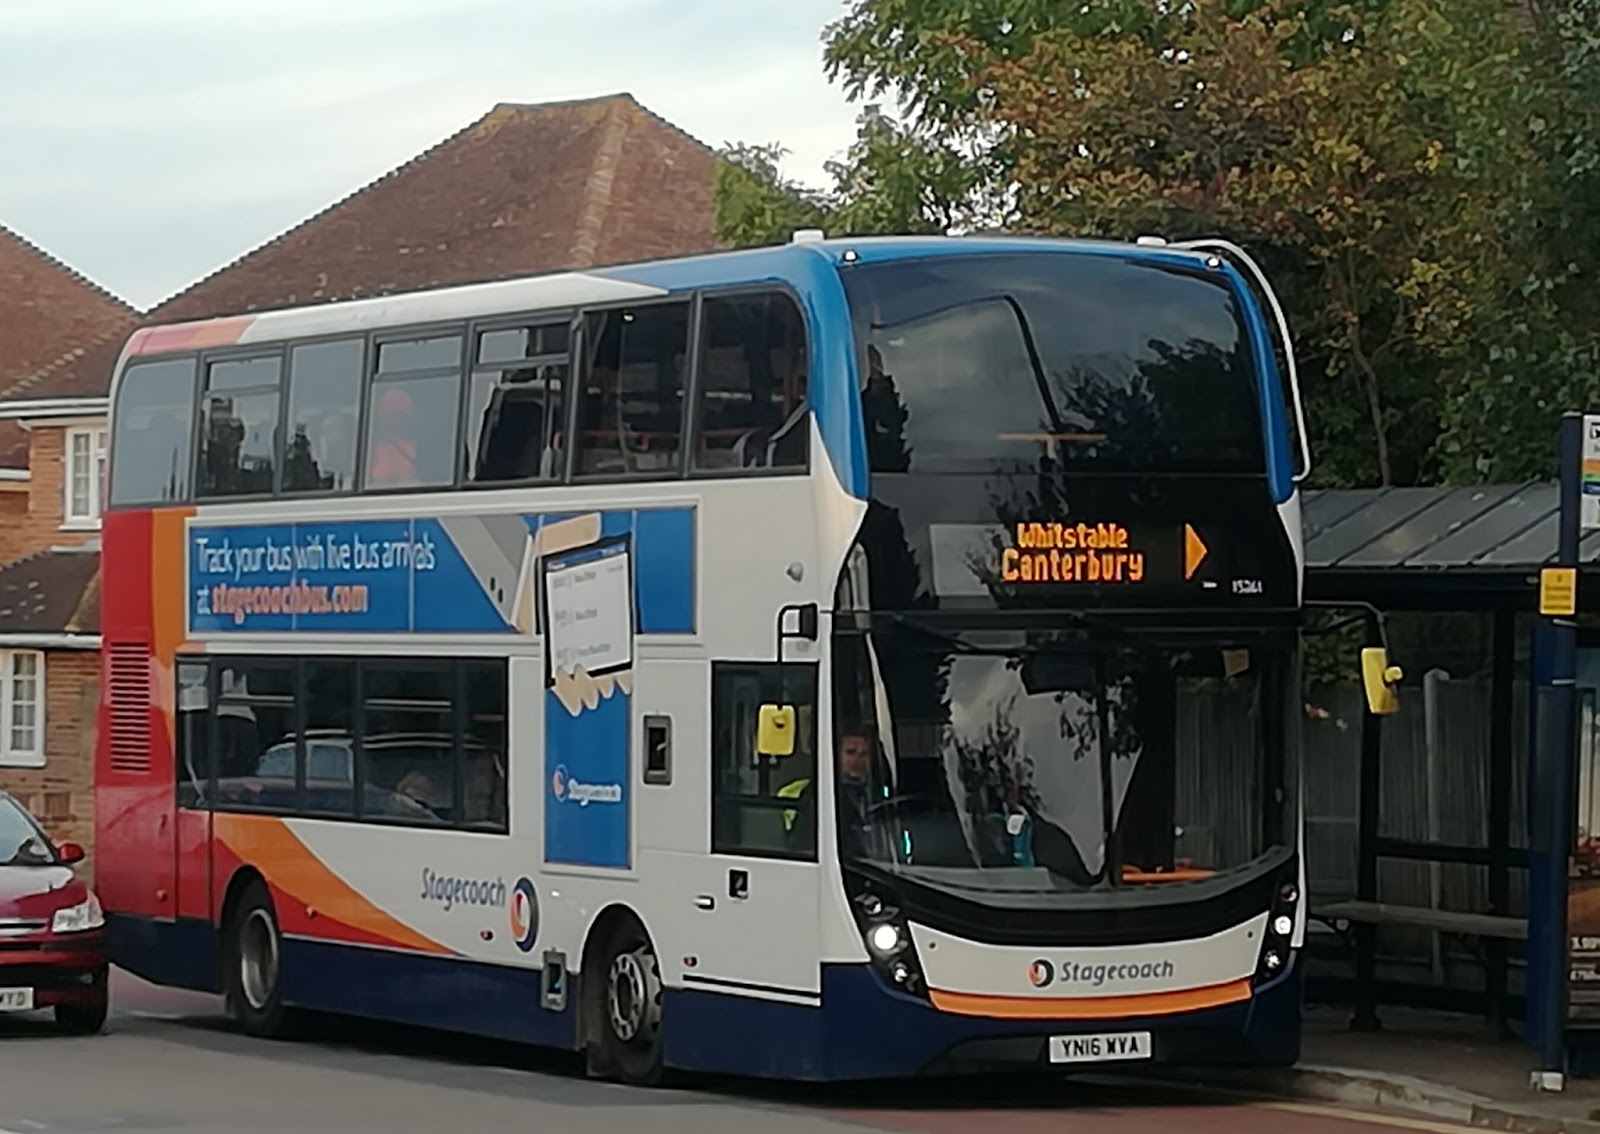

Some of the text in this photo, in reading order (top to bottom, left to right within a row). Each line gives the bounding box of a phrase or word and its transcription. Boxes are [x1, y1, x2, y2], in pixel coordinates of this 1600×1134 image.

[1017, 522, 1128, 549] Whitstable
[196, 530, 435, 581] Track your bus with live bus arrivals
[1002, 549, 1144, 582] Canterbury
[196, 579, 368, 625] at stagecoachbus.com
[421, 867, 506, 912] Stagecoach
[1061, 959, 1174, 986] Stagecoach
[1062, 1037, 1101, 1057] YN16
